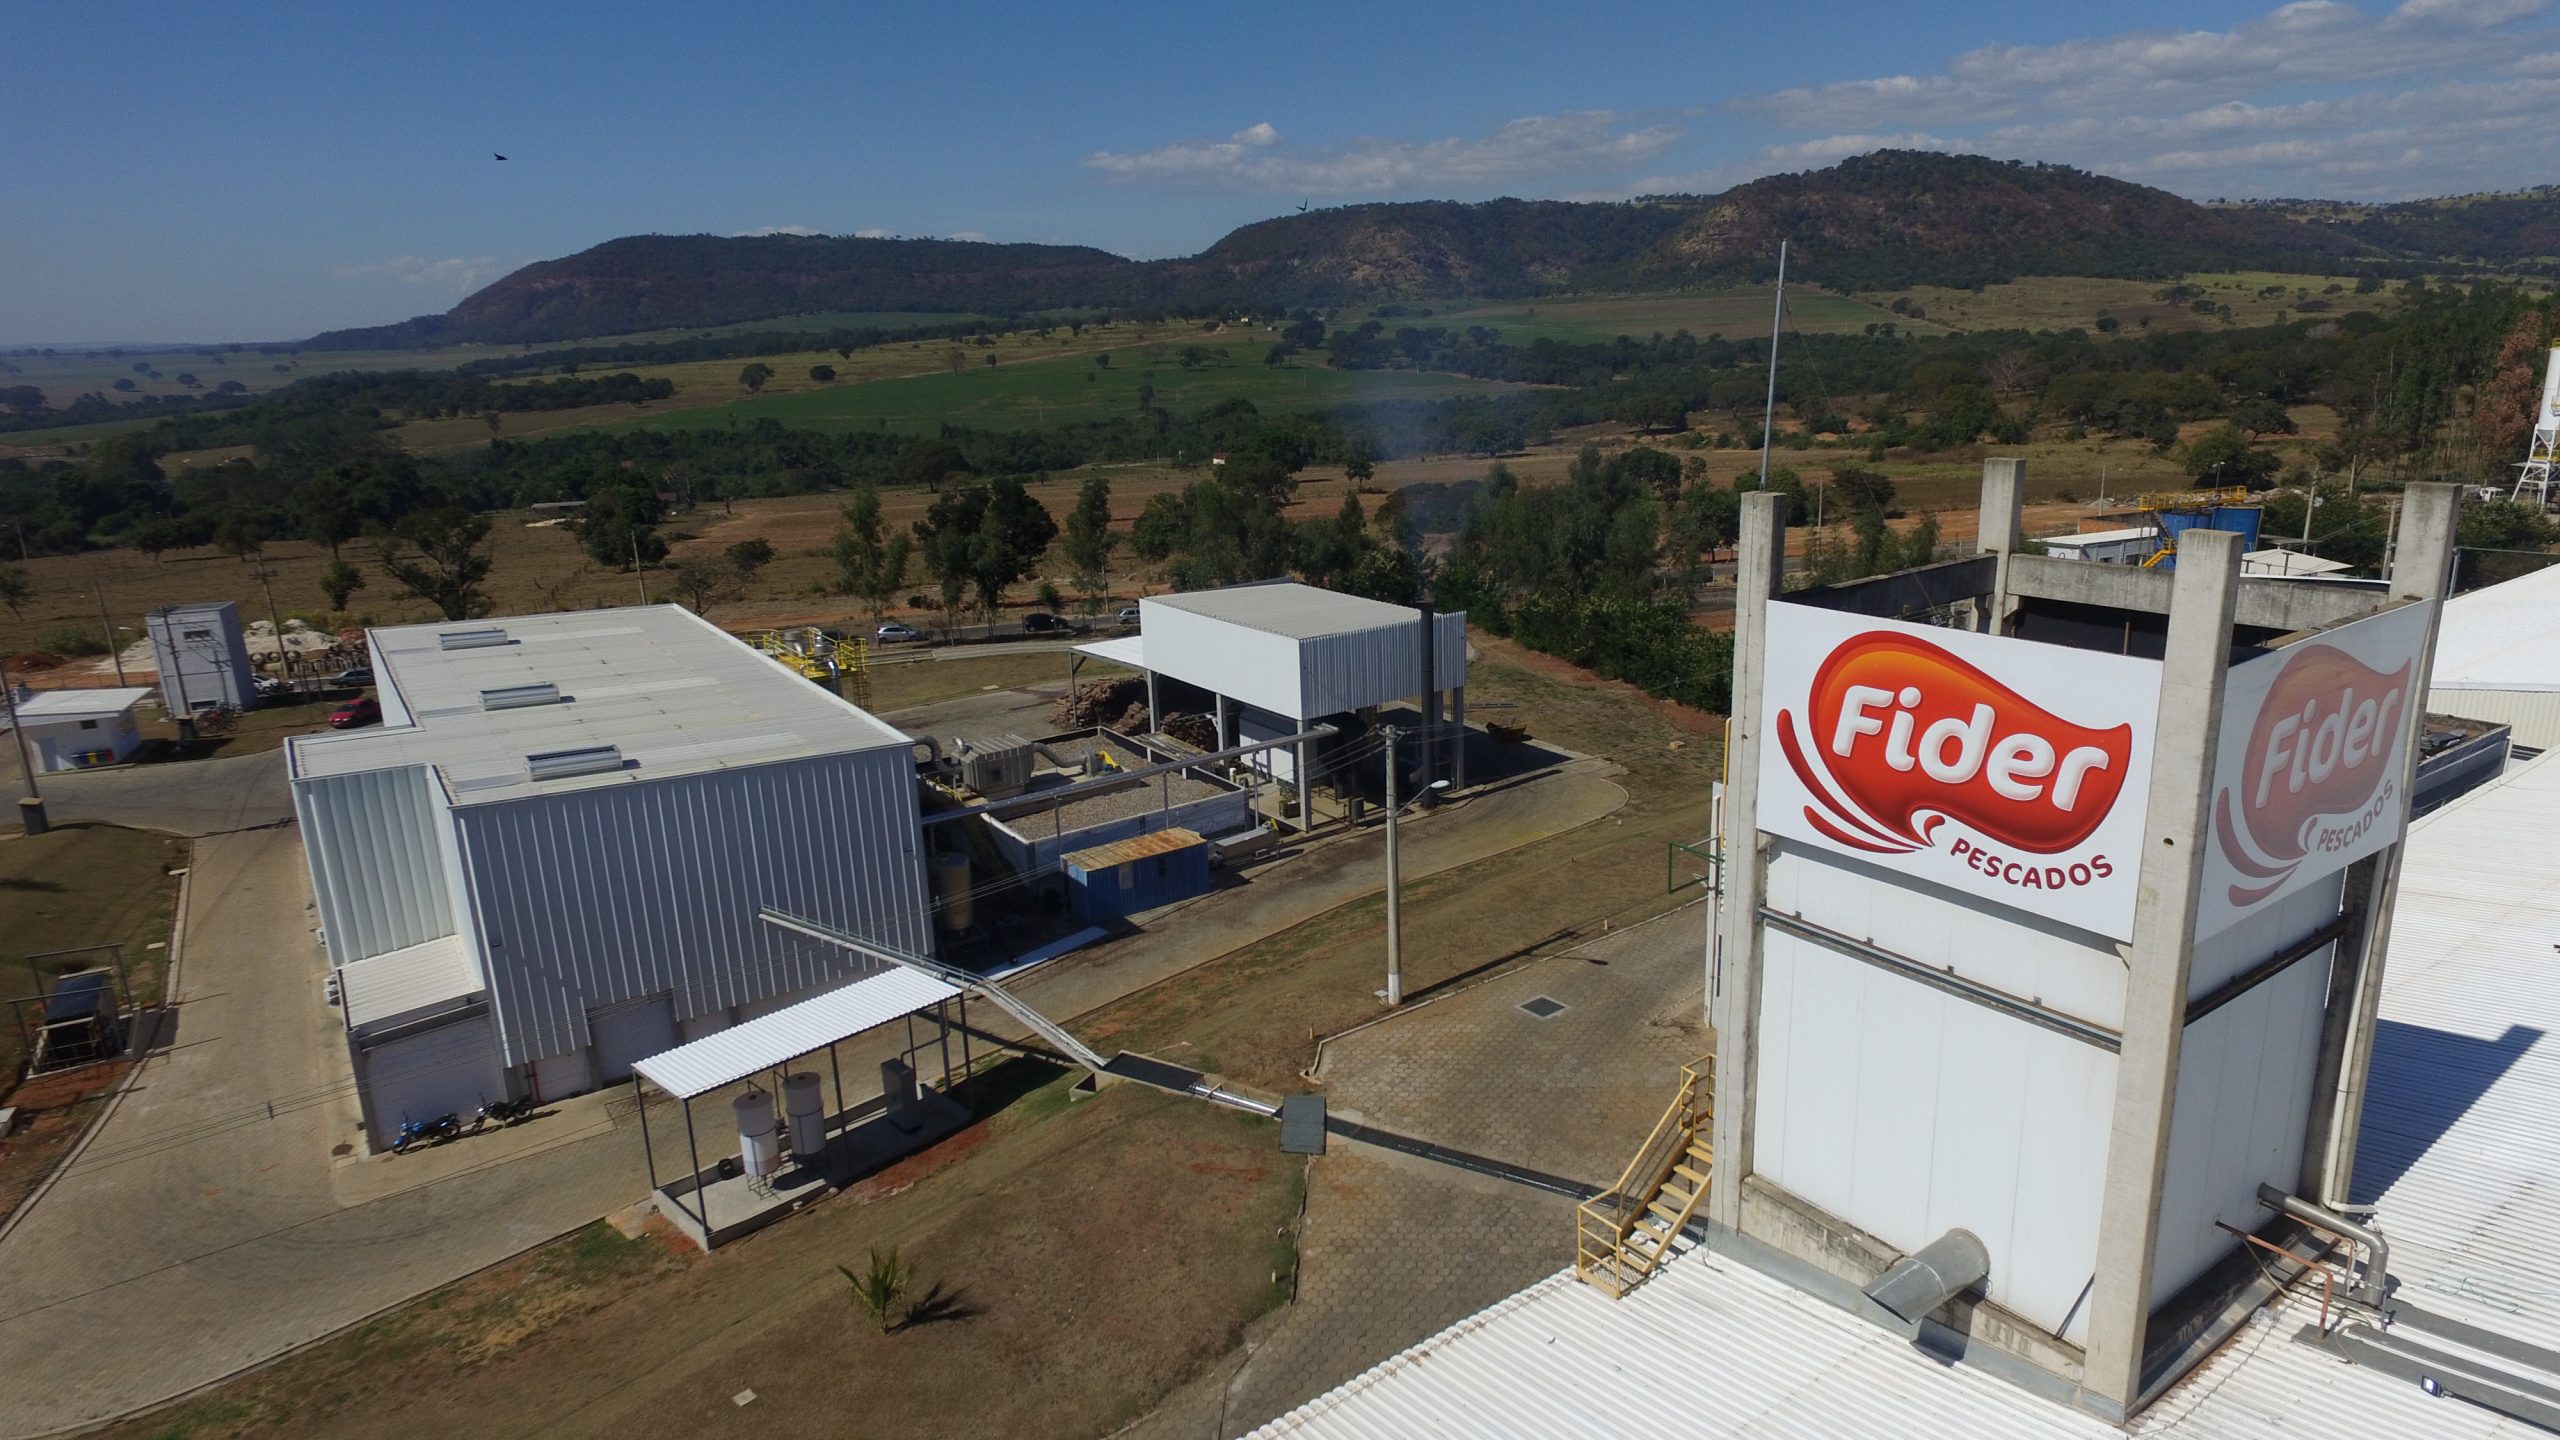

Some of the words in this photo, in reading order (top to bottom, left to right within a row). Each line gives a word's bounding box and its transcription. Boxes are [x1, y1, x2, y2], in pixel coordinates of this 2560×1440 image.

[1832, 685, 2110, 812] Fider
[2255, 687, 2399, 808] Fider
[1950, 837, 2113, 890] PESCADOS
[2317, 779, 2393, 852] PESCADOS
